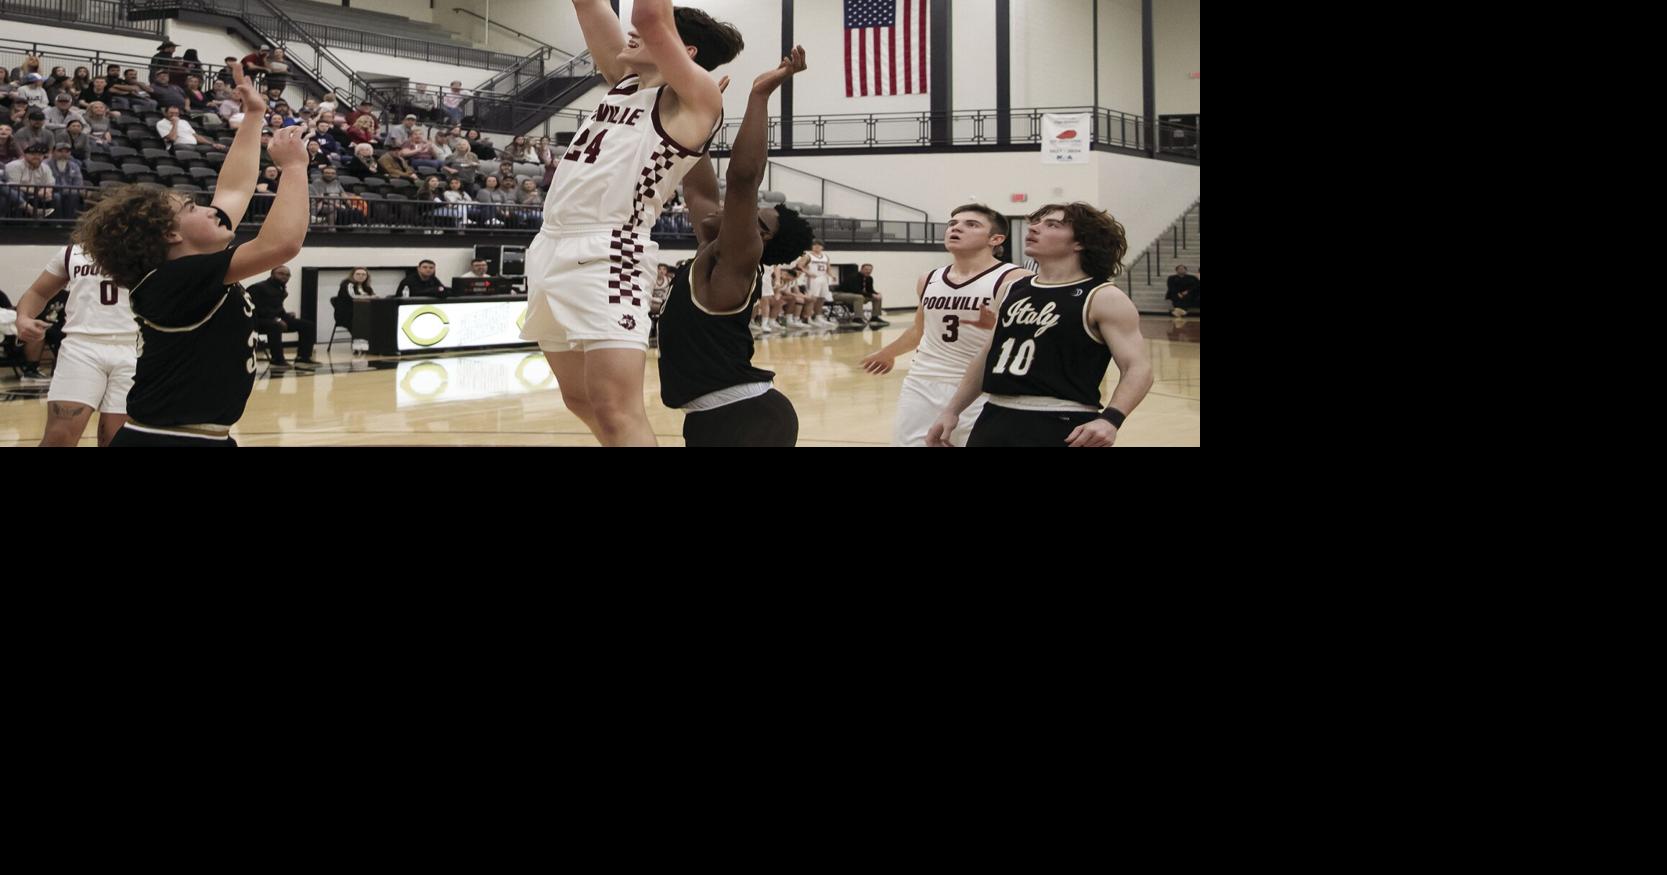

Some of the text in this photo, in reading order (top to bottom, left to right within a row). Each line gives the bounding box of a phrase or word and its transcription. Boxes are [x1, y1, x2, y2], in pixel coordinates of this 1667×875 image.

[591, 103, 645, 126] VILLE
[563, 127, 609, 164] 24
[74, 264, 101, 278] POO
[100, 280, 118, 305] 0
[923, 296, 991, 311] POOLVILLE
[942, 314, 960, 342] 3
[1002, 296, 1061, 338] Italy
[992, 337, 1036, 376] 10
